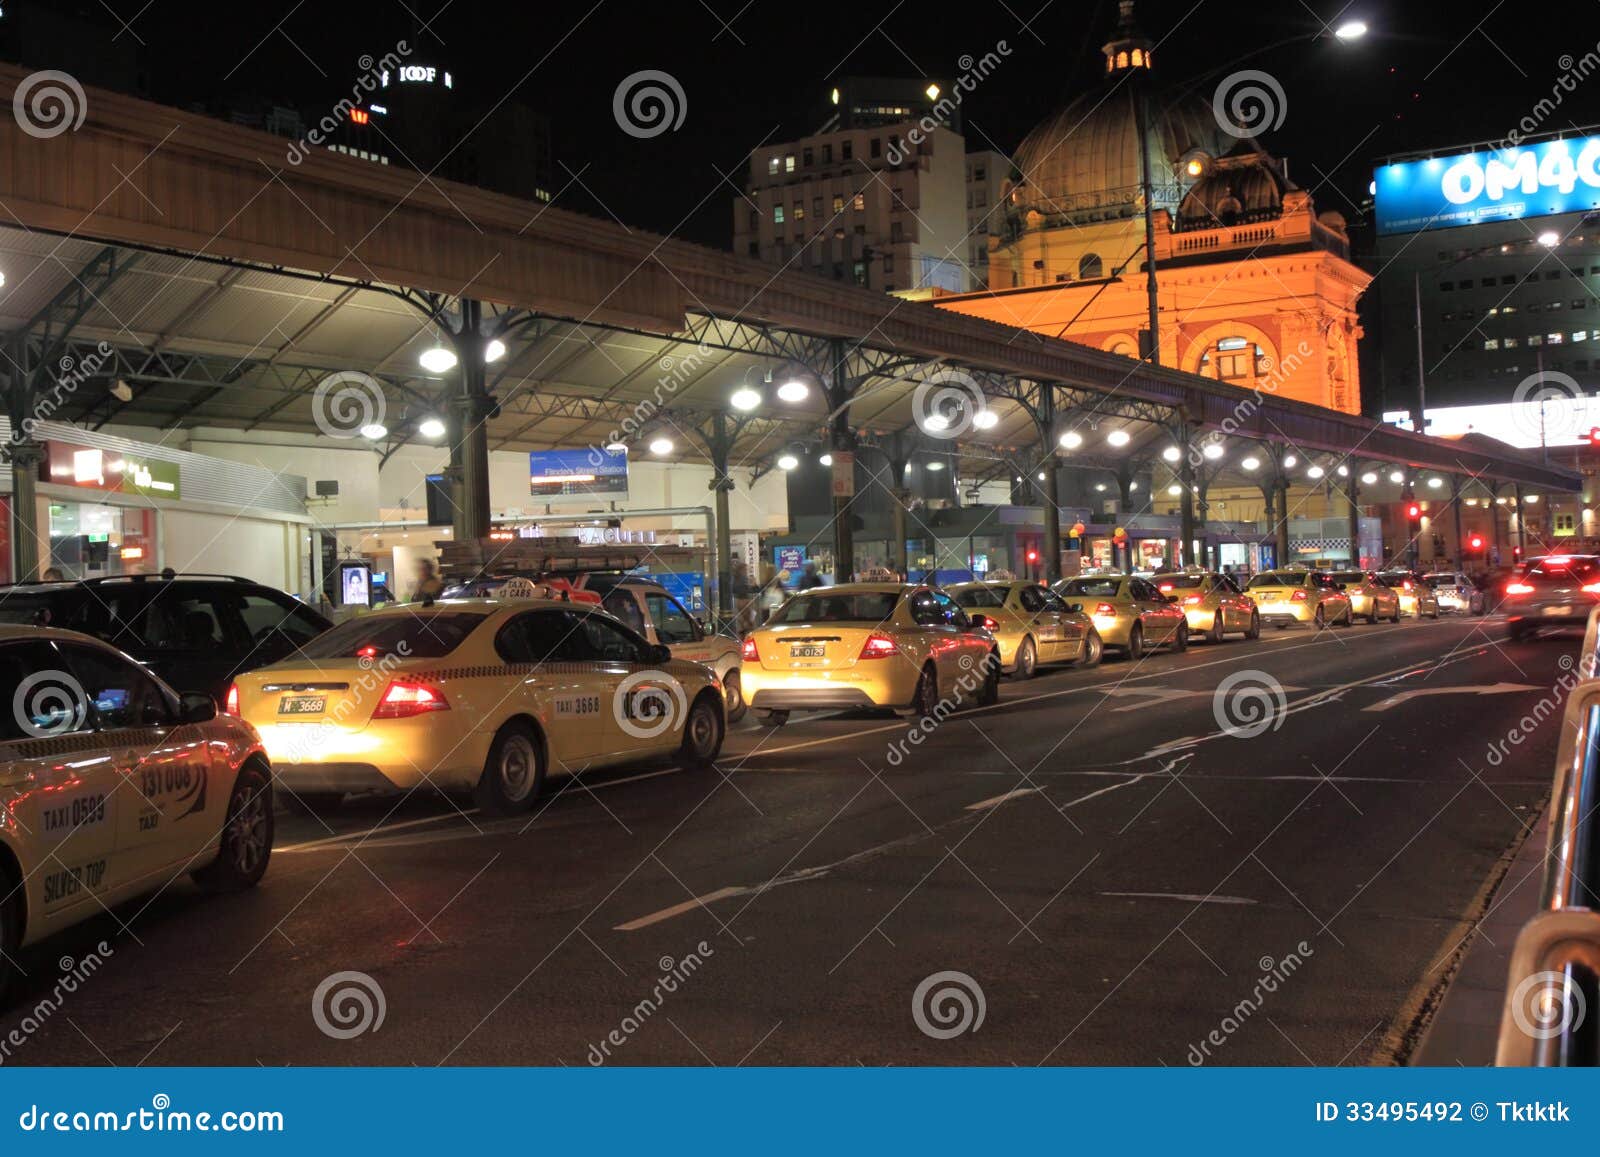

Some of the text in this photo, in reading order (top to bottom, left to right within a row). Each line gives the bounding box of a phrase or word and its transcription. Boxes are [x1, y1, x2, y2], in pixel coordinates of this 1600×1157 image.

[298, 700, 324, 712] 3668
[556, 700, 572, 713] TAXI
[44, 805, 70, 831] TAXI
[44, 860, 106, 903] SILVER TOP
